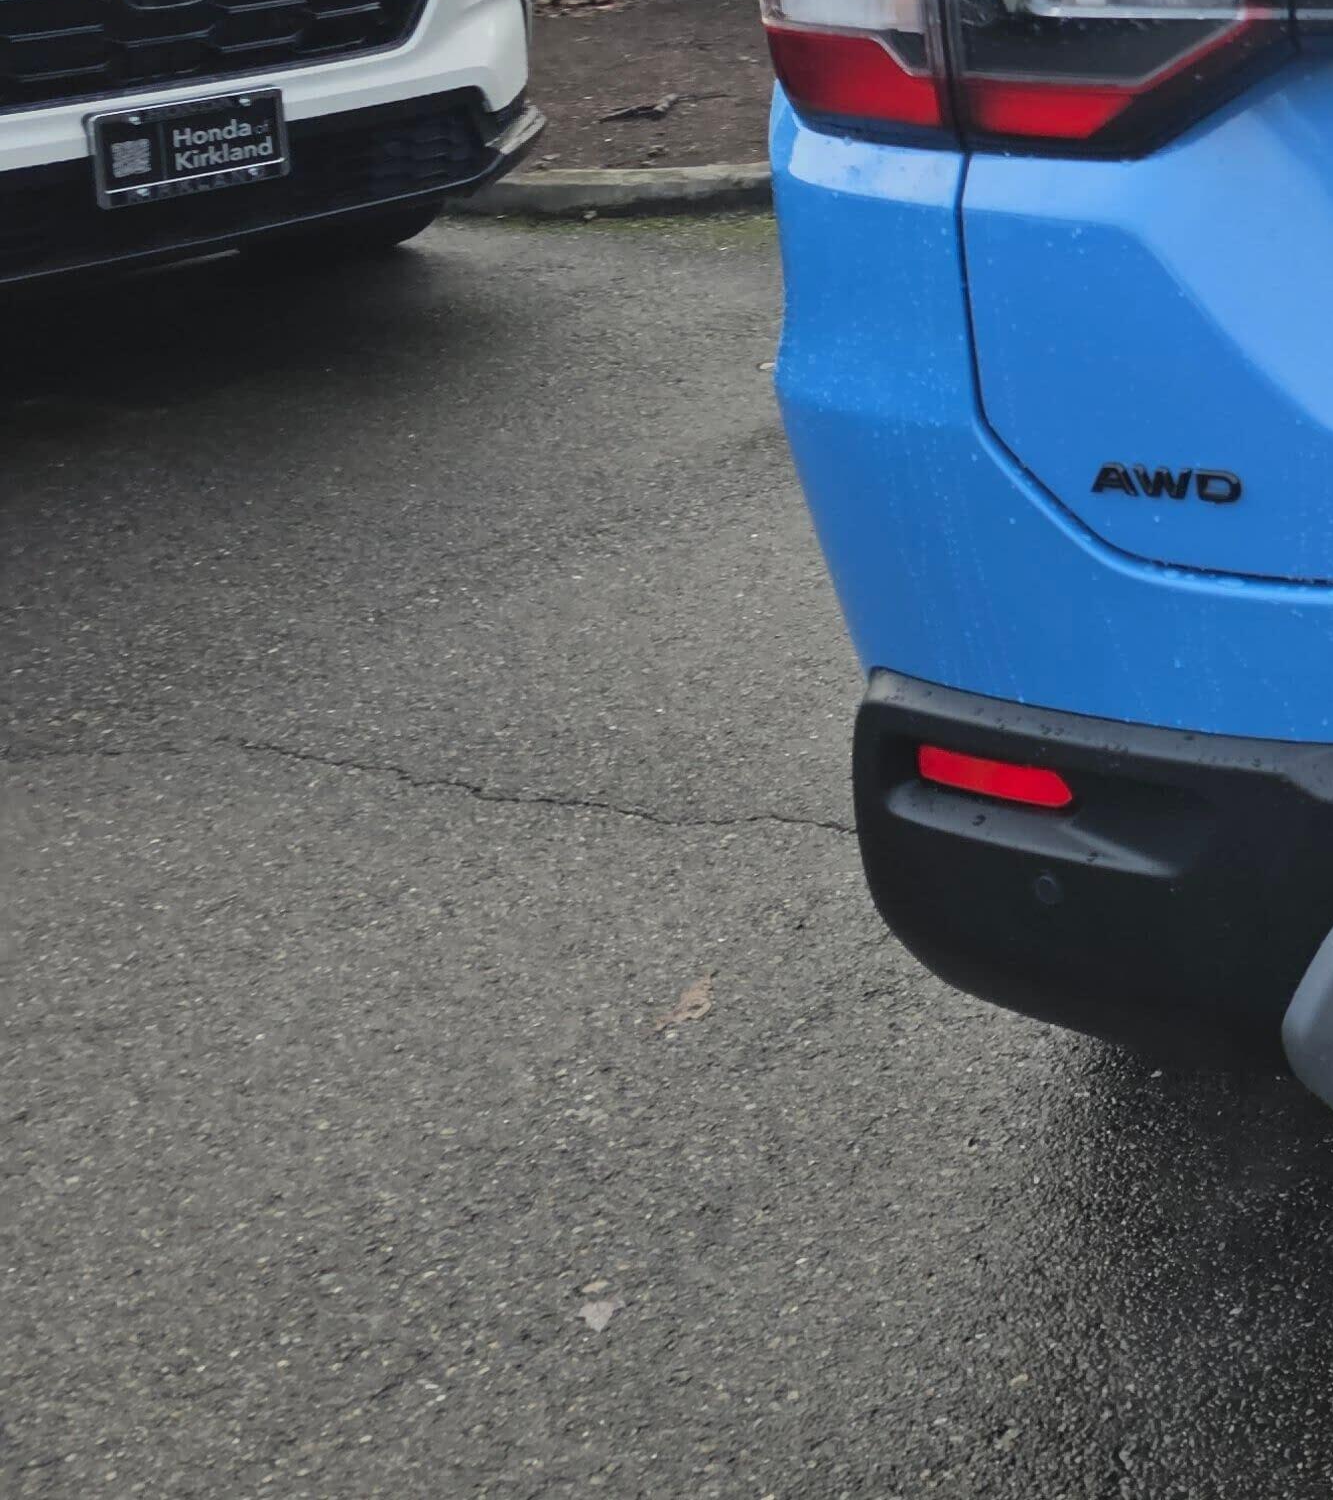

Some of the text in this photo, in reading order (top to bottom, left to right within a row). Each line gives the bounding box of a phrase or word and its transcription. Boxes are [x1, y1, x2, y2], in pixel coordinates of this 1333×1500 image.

[172, 118, 252, 148] Honda
[175, 136, 274, 171] Kirkland
[1090, 462, 1242, 503] AWD
